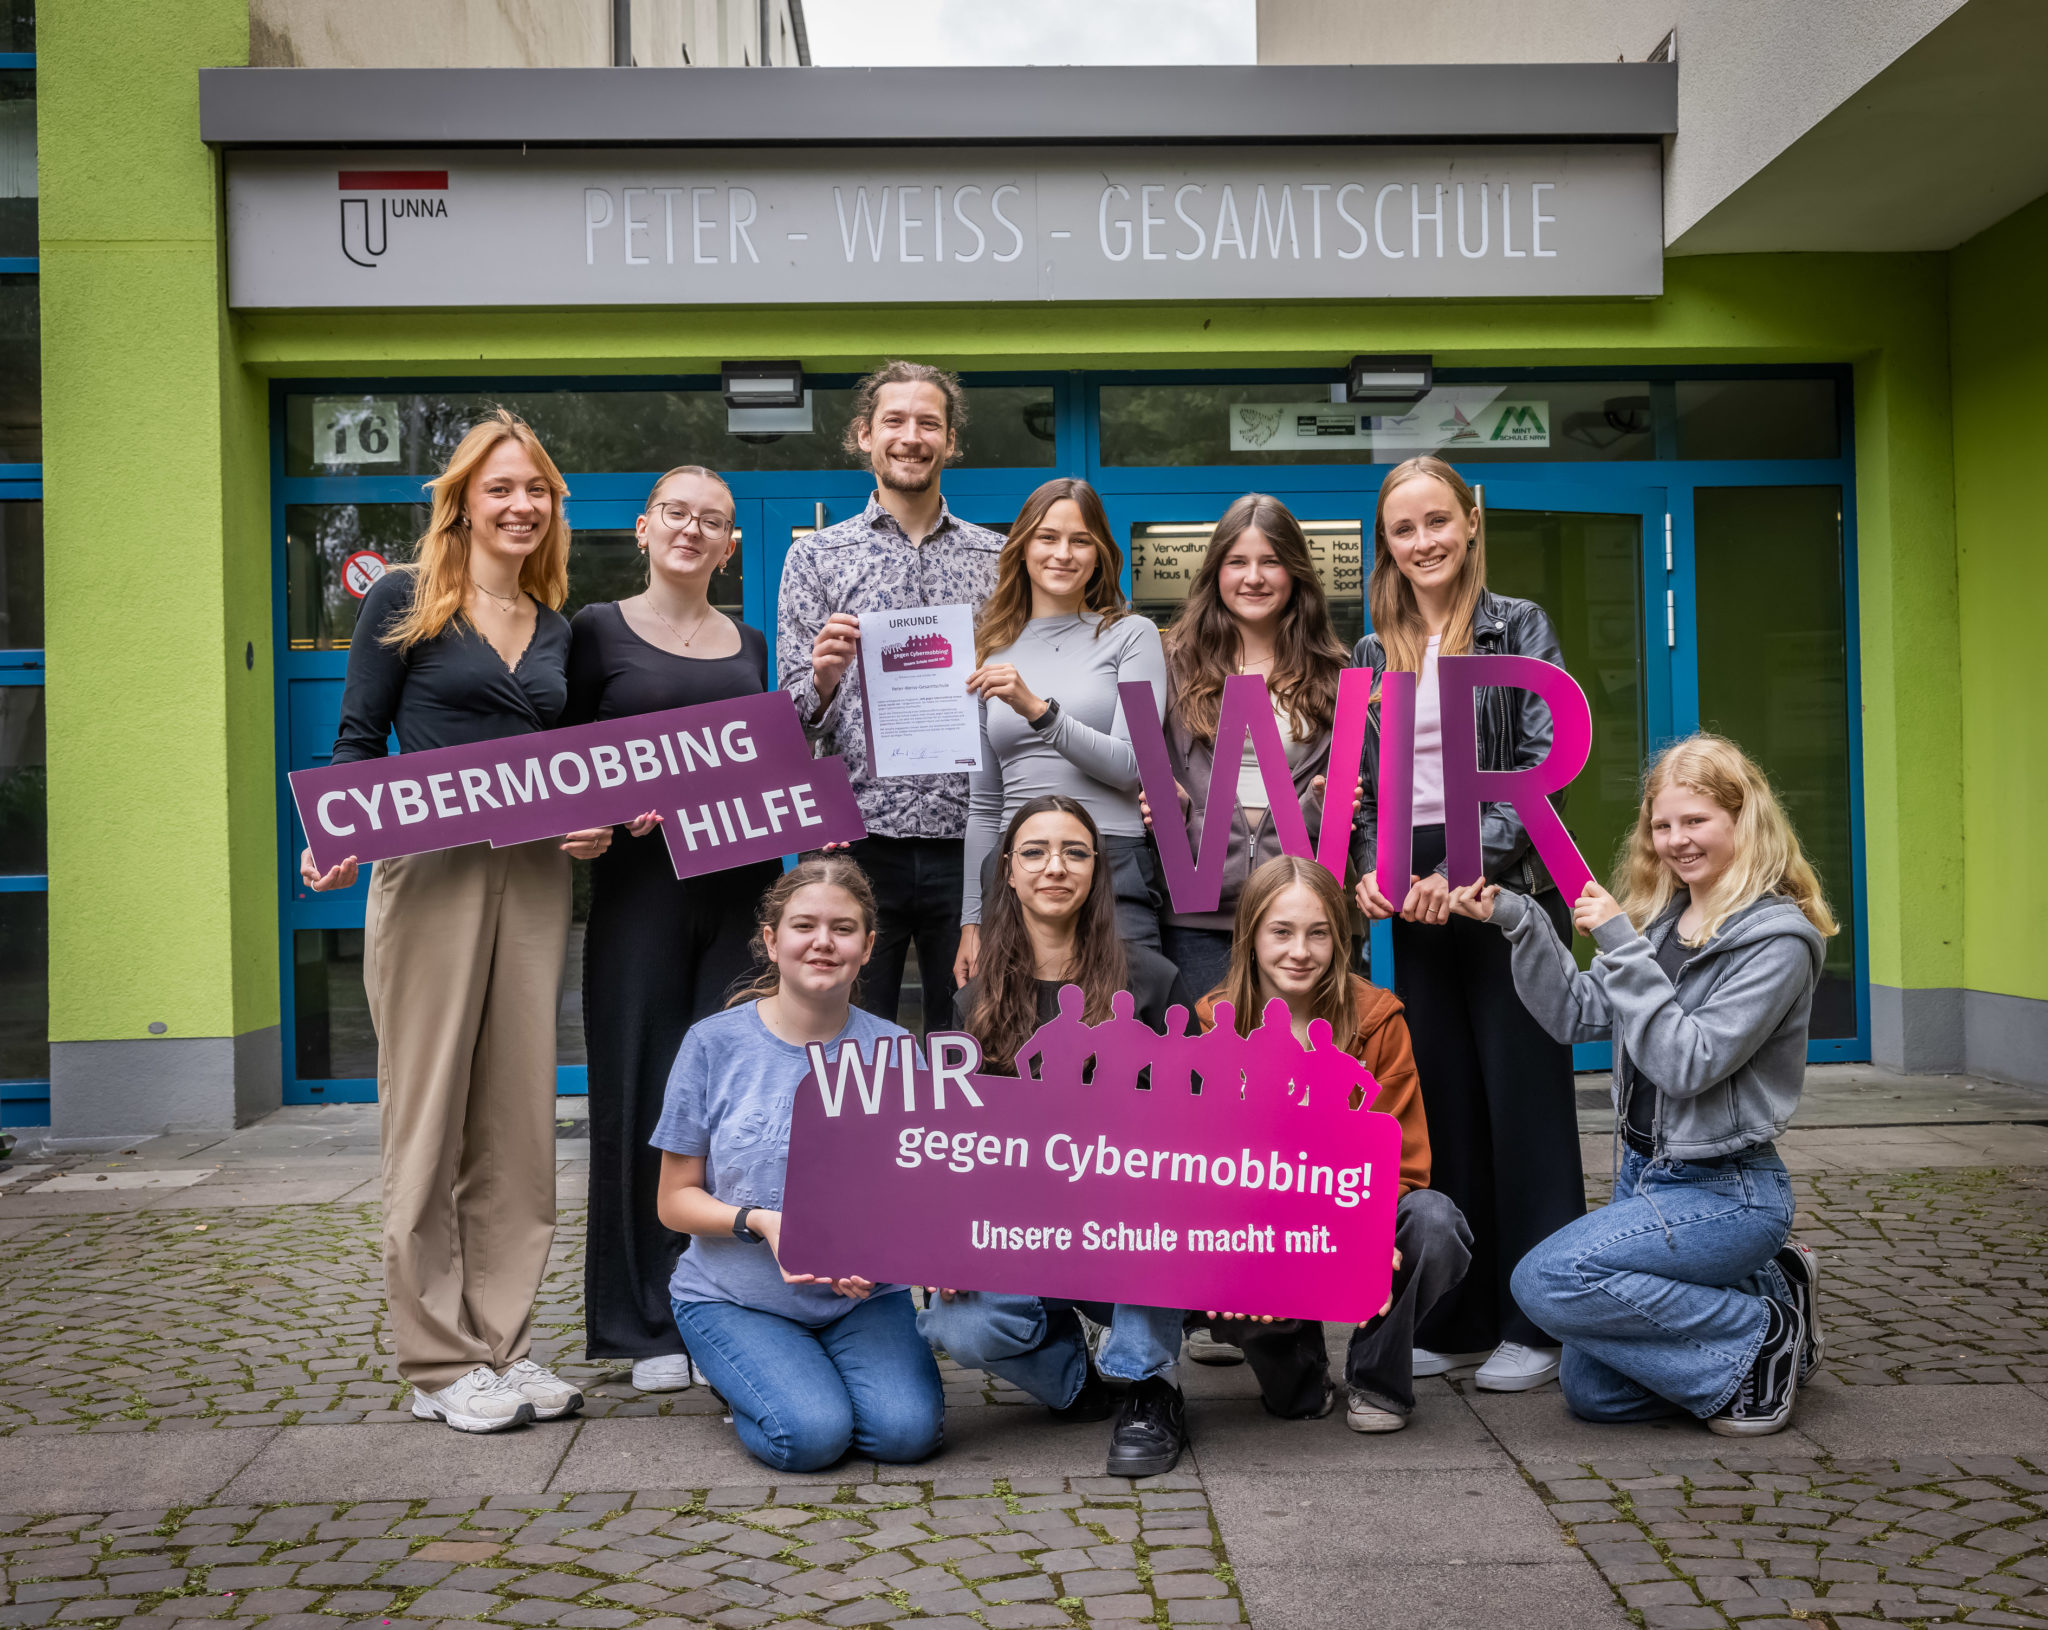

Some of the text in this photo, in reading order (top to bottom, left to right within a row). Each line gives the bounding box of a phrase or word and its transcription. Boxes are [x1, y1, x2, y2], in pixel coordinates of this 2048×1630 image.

[392, 199, 448, 218] UNNA
[584, 187, 760, 264] PETER
[833, 185, 1024, 262] WEISS
[1099, 182, 1557, 261] GESAMTSCHULE
[327, 415, 389, 454] 16
[1152, 543, 1208, 553] Verwaltun
[1333, 541, 1359, 551] Haus
[1333, 554, 1359, 564] Haus
[1153, 556, 1178, 566] Aula
[1154, 569, 1180, 580] Haus
[889, 615, 939, 628] URKUNDE
[881, 643, 903, 656] WIR
[316, 720, 759, 837] CYBERMOBBING
[1118, 655, 1595, 914] WIR
[677, 783, 823, 851] HILFE
[806, 1035, 985, 1118] WIR
[895, 1126, 1374, 1208] gegen Cybermobbing!
[971, 1220, 1338, 1254] Unsere Schule macht mit.
